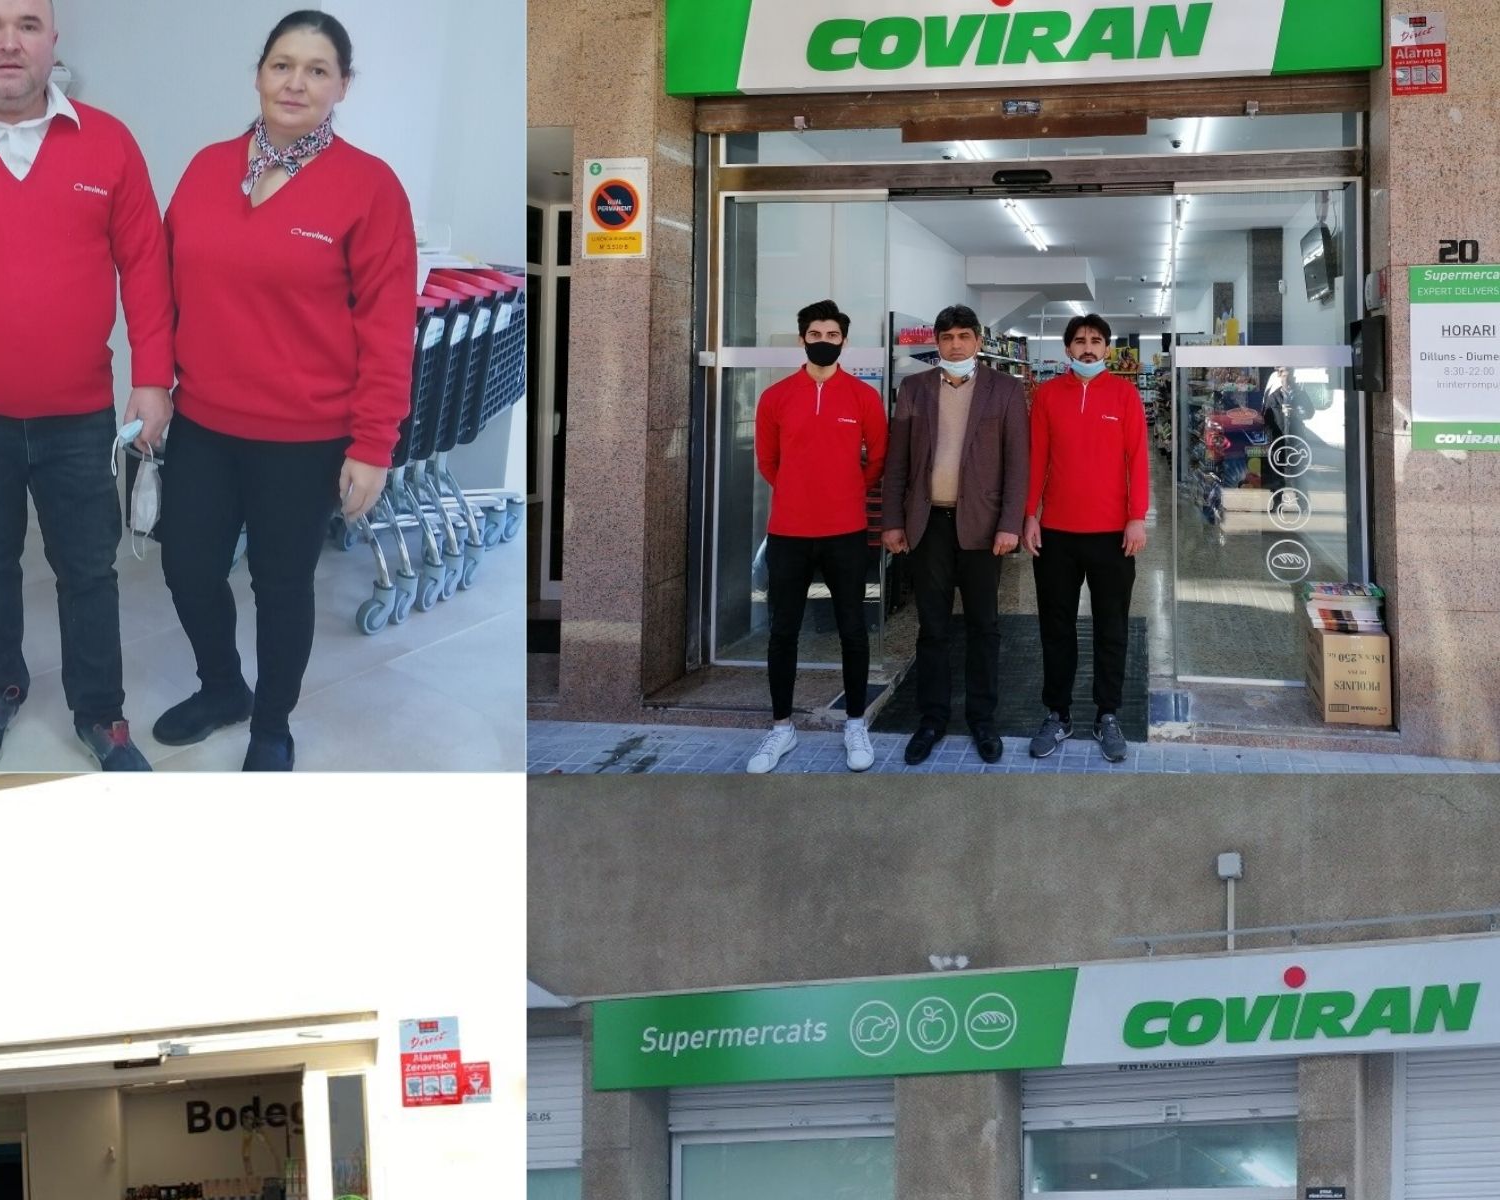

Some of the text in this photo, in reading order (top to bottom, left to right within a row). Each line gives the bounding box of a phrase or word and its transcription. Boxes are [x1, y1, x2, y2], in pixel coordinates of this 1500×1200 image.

[805, 2, 1213, 72] COVIRAN
[1396, 47, 1442, 59] Alarma
[1439, 240, 1479, 263] 20
[1418, 287, 1452, 296] EXPERT
[1442, 325, 1495, 336] HORARI
[1420, 351, 1456, 361] Dilluns
[1444, 367, 1495, 376] 8:30-22:00
[1334, 680, 1380, 691] PICOLINES
[1123, 966, 1480, 1049] COVIRAN
[640, 1018, 827, 1057] Supermercats
[413, 1053, 447, 1062] Alarma
